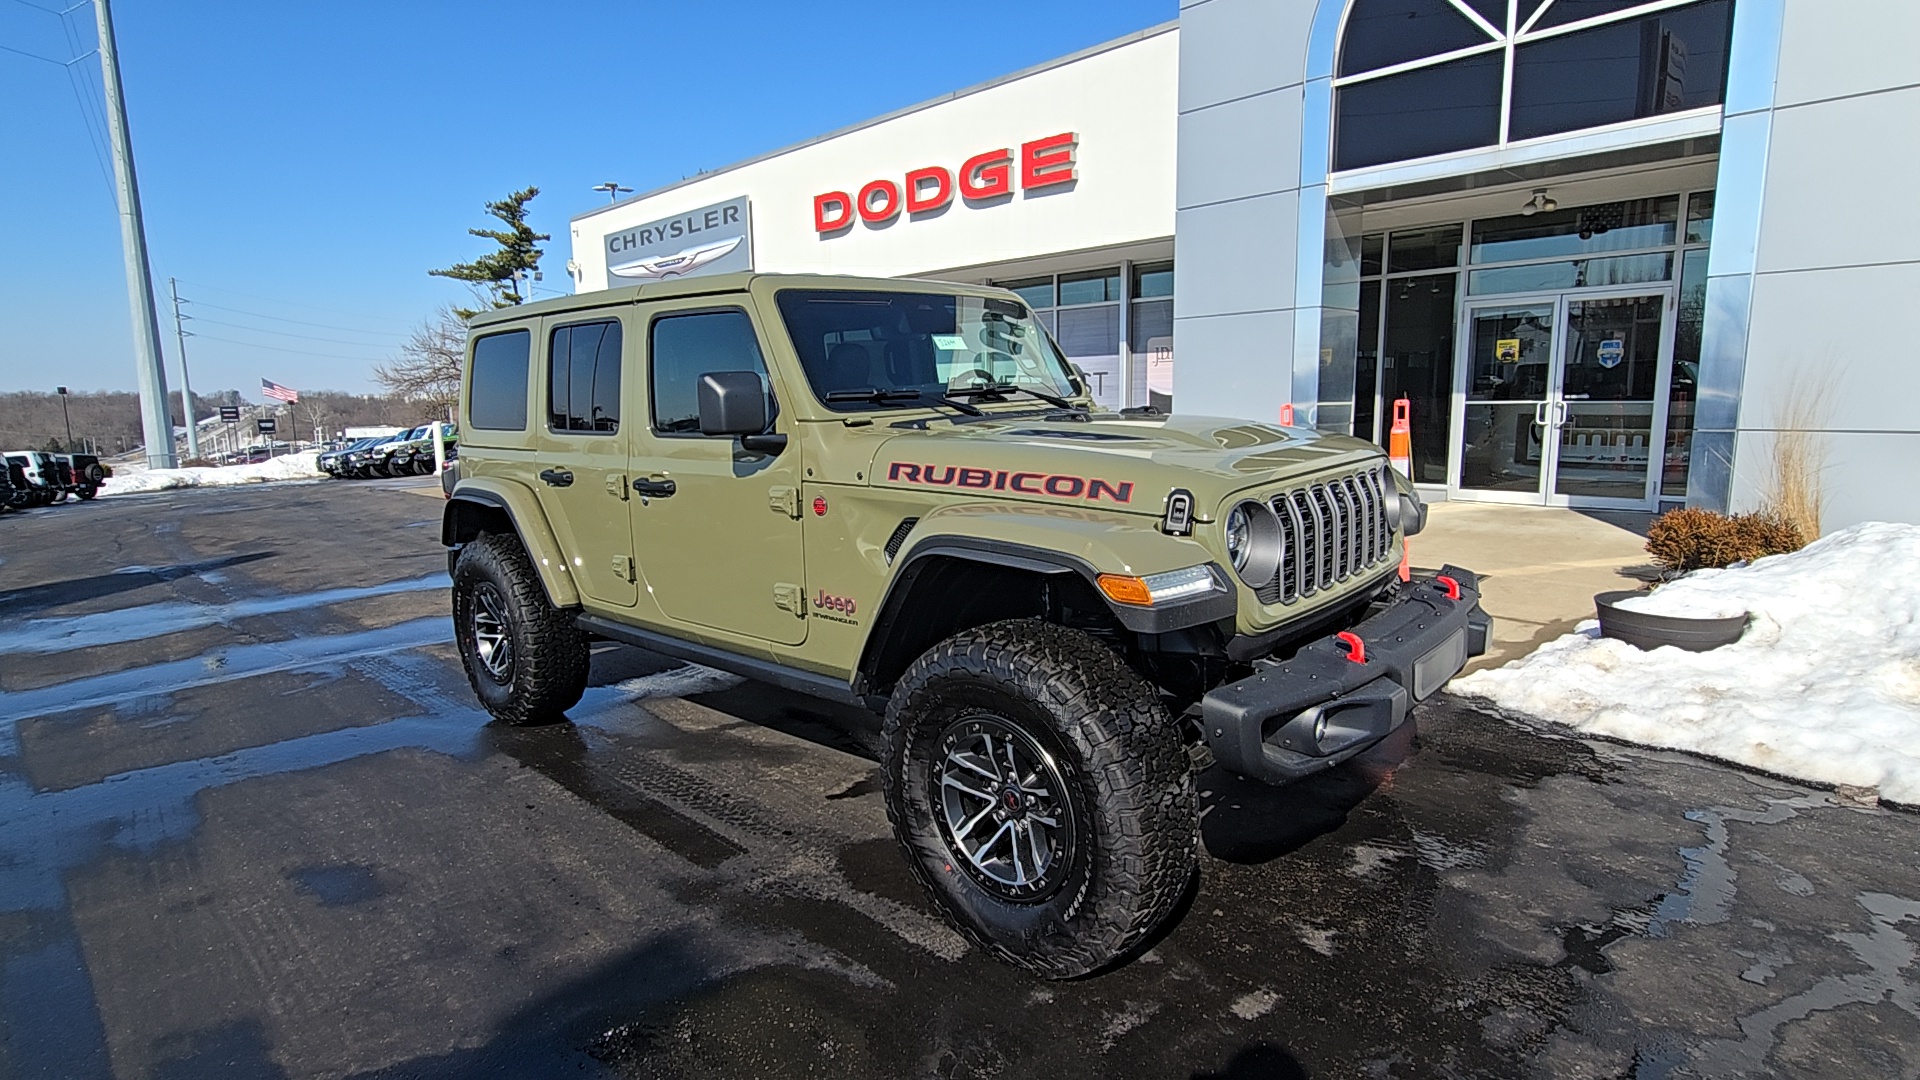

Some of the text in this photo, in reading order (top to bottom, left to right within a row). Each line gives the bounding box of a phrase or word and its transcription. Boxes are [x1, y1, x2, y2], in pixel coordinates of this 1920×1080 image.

[814, 132, 1078, 233] DODGE
[609, 205, 740, 253] CHRYSLER
[887, 461, 1135, 504] RUBICON
[812, 588, 857, 617] Jeep
